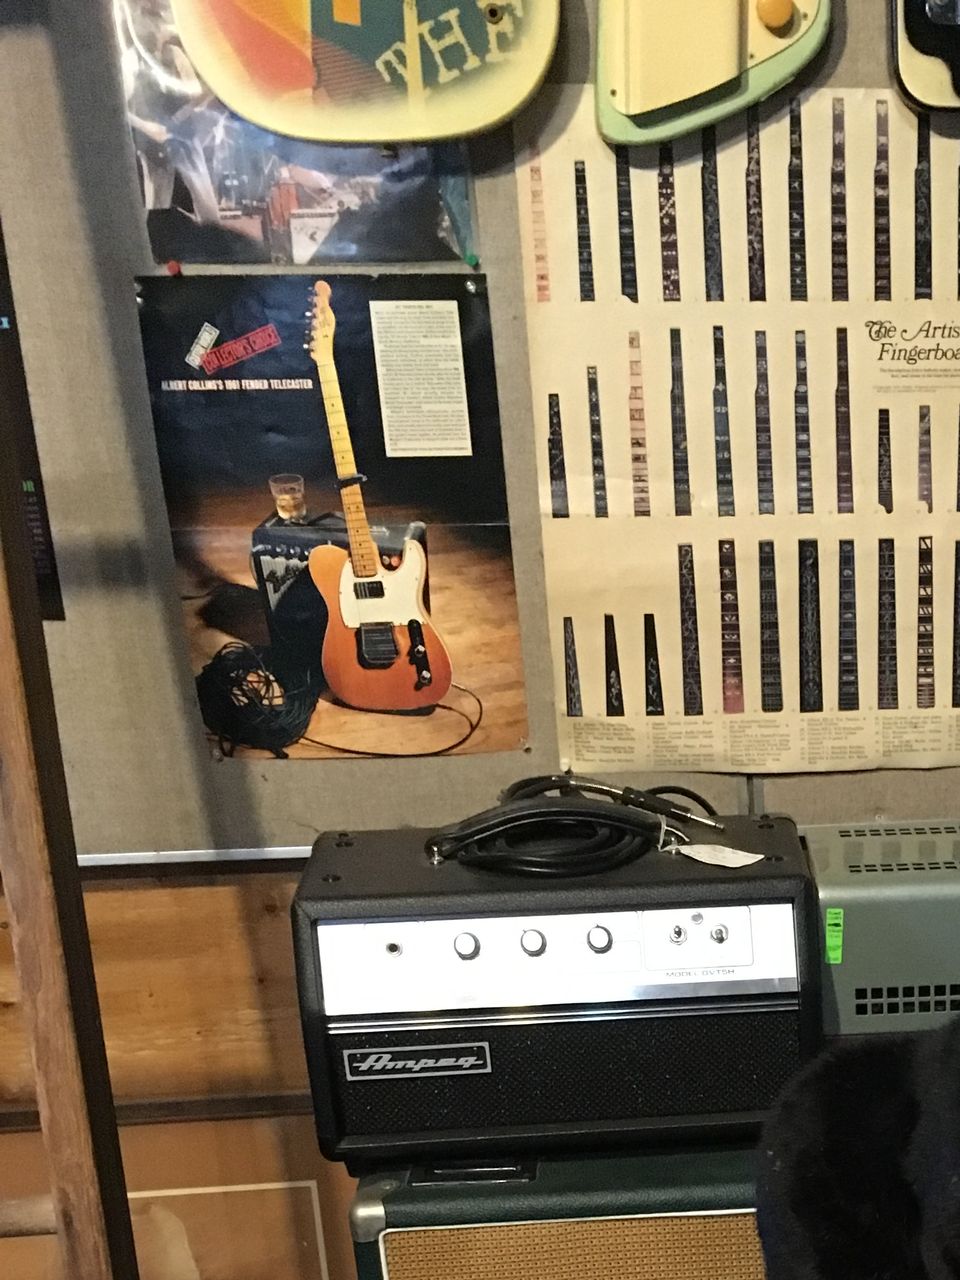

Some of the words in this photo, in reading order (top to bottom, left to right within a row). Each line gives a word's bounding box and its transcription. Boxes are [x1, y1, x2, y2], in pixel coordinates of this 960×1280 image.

[865, 320, 896, 342] The
[161, 379, 187, 391] ALBERT
[242, 379, 270, 390] FENDER
[271, 379, 313, 390] TELECASTER
[352, 1052, 484, 1074] Ampeg
